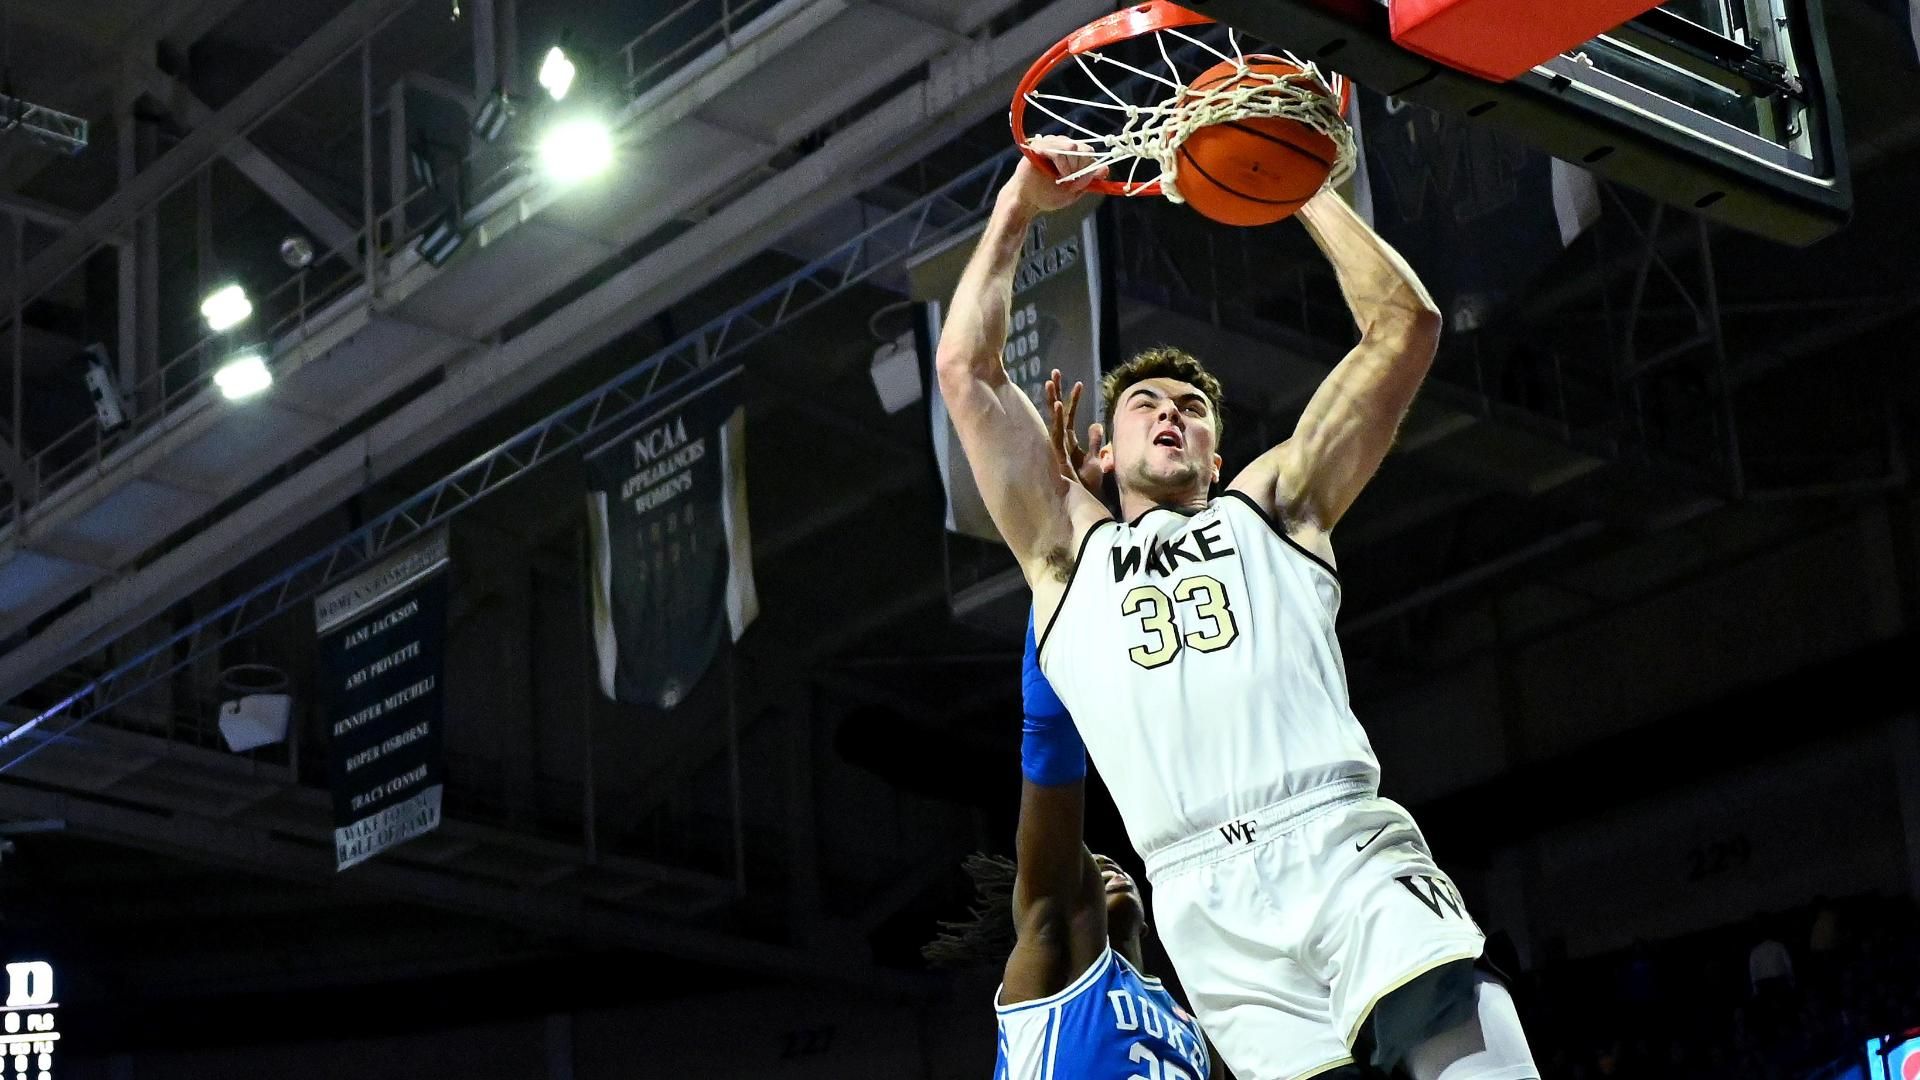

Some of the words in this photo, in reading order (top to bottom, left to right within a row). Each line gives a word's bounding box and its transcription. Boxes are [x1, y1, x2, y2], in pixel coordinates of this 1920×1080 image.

[634, 416, 688, 470] NCAA
[621, 438, 706, 500] APPEARANCES
[1112, 520, 1235, 583] WAKE
[345, 626, 370, 650] JANE
[371, 599, 418, 636] JACKSON
[1121, 575, 1239, 670] 33
[345, 669, 367, 691] AMY
[333, 703, 382, 737] JENNIFER
[1220, 820, 1258, 845] WF
[5, 960, 54, 1008] D
